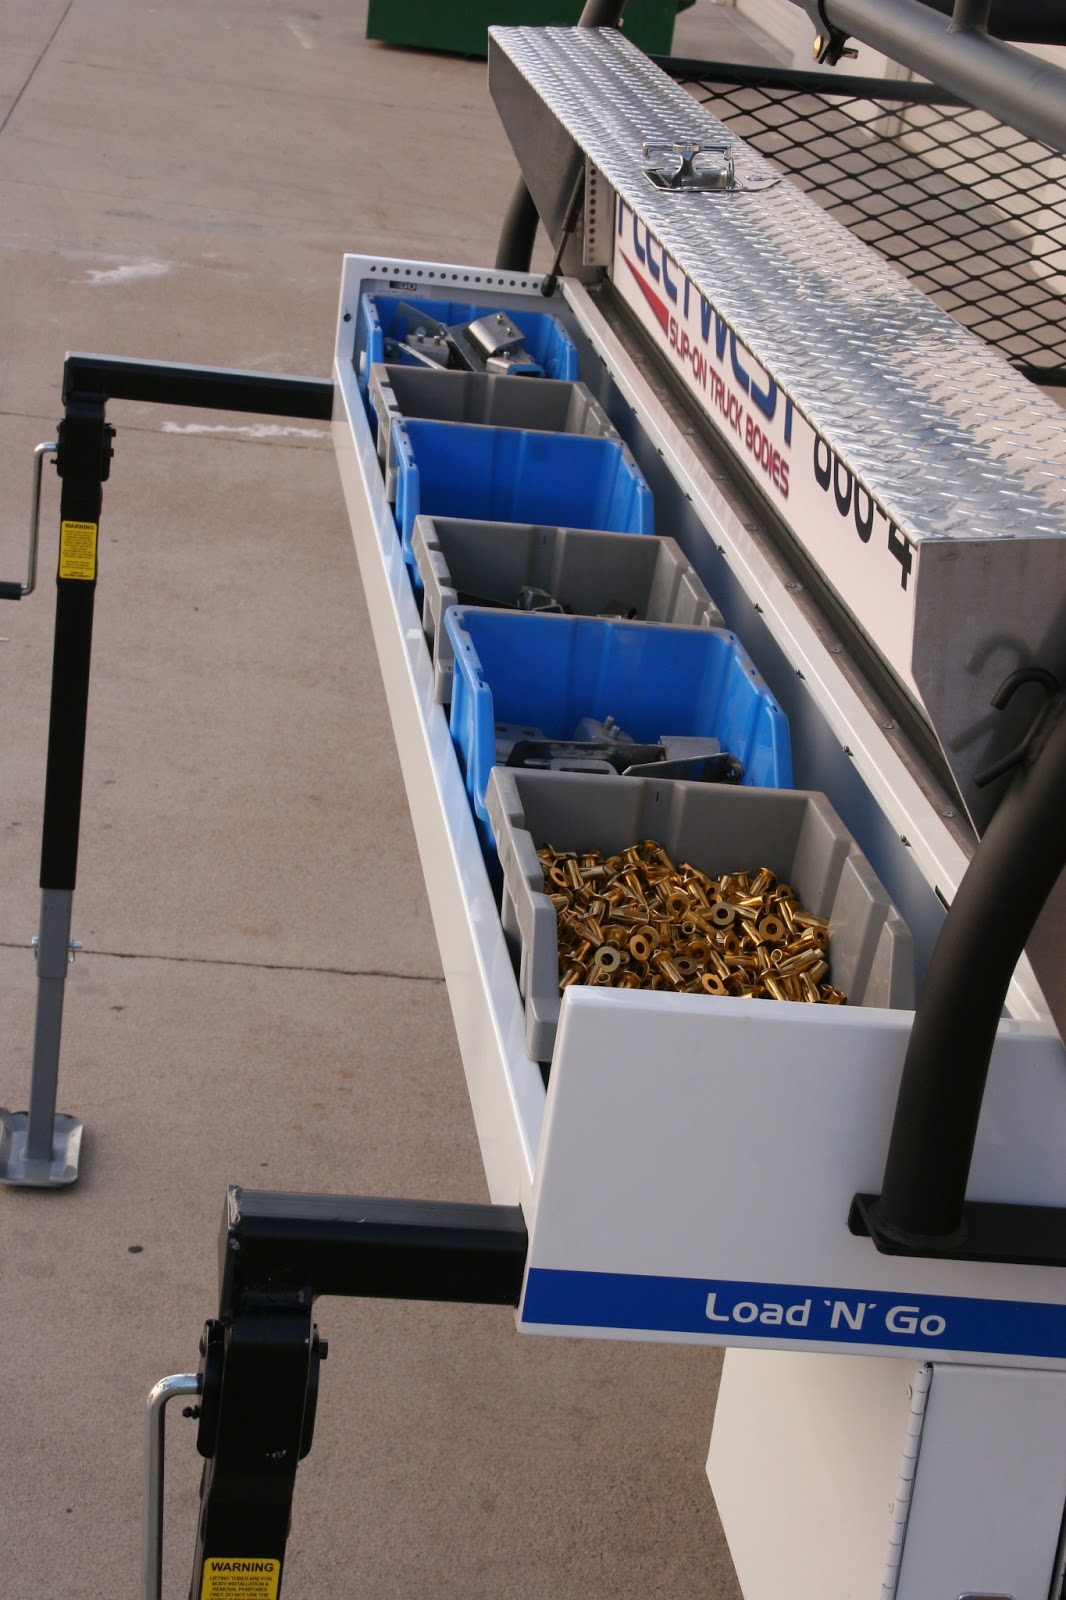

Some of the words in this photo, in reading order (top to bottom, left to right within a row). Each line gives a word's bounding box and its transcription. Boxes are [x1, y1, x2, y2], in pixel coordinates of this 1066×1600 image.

[669, 316, 707, 390] SLIP-ON
[710, 366, 743, 438] TRUCK
[745, 413, 790, 500] BODIES
[704, 1292, 812, 1327] Load
[884, 1304, 947, 1337] Go
[211, 1562, 274, 1572] WARNING
